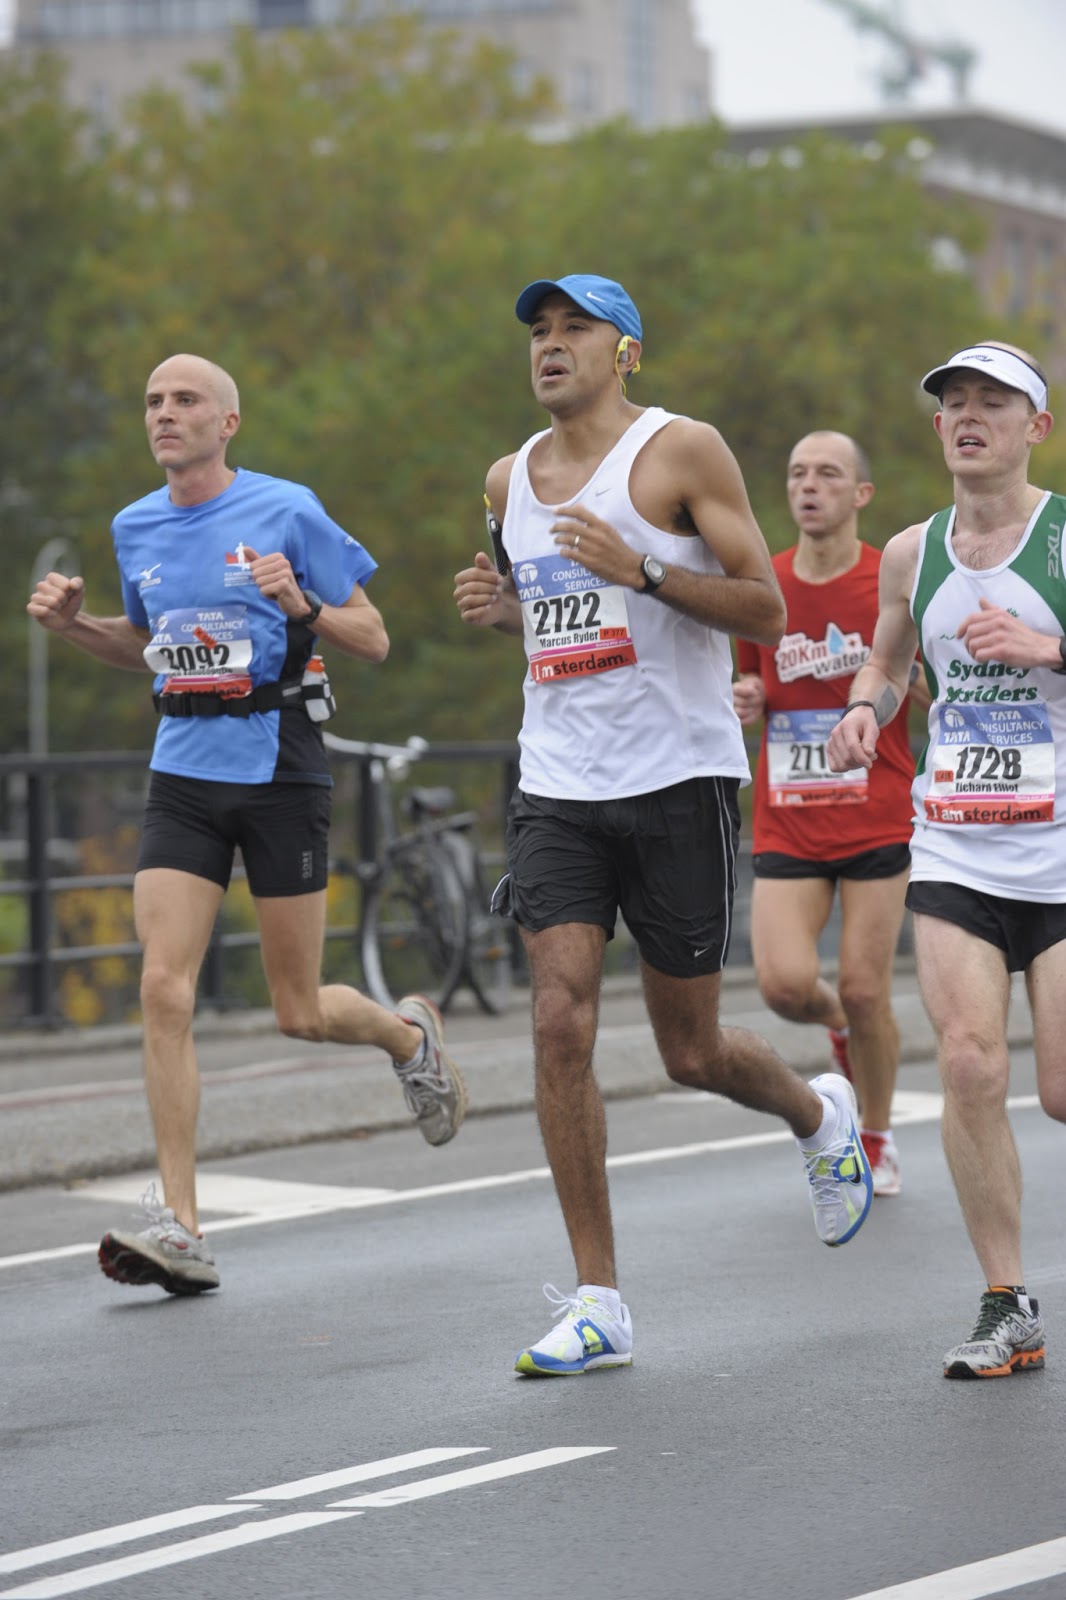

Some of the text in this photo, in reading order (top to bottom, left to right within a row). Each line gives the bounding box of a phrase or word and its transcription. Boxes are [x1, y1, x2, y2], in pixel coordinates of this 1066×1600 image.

[1047, 522, 1061, 578] 2XU
[551, 567, 593, 582] CONSUL
[564, 576, 607, 592] SERVICES
[518, 585, 545, 600] TATA
[197, 612, 224, 621] TATA
[533, 592, 602, 636] 2722
[181, 620, 244, 632] CONSULTANCY
[540, 635, 572, 648] Marcus
[573, 631, 599, 644] Ryder
[990, 710, 1022, 721] TATA
[944, 731, 970, 744] TATA
[987, 733, 1033, 745] SERVICES
[790, 744, 826, 771] 271
[955, 746, 1022, 780] 1728
[930, 803, 938, 818] I
